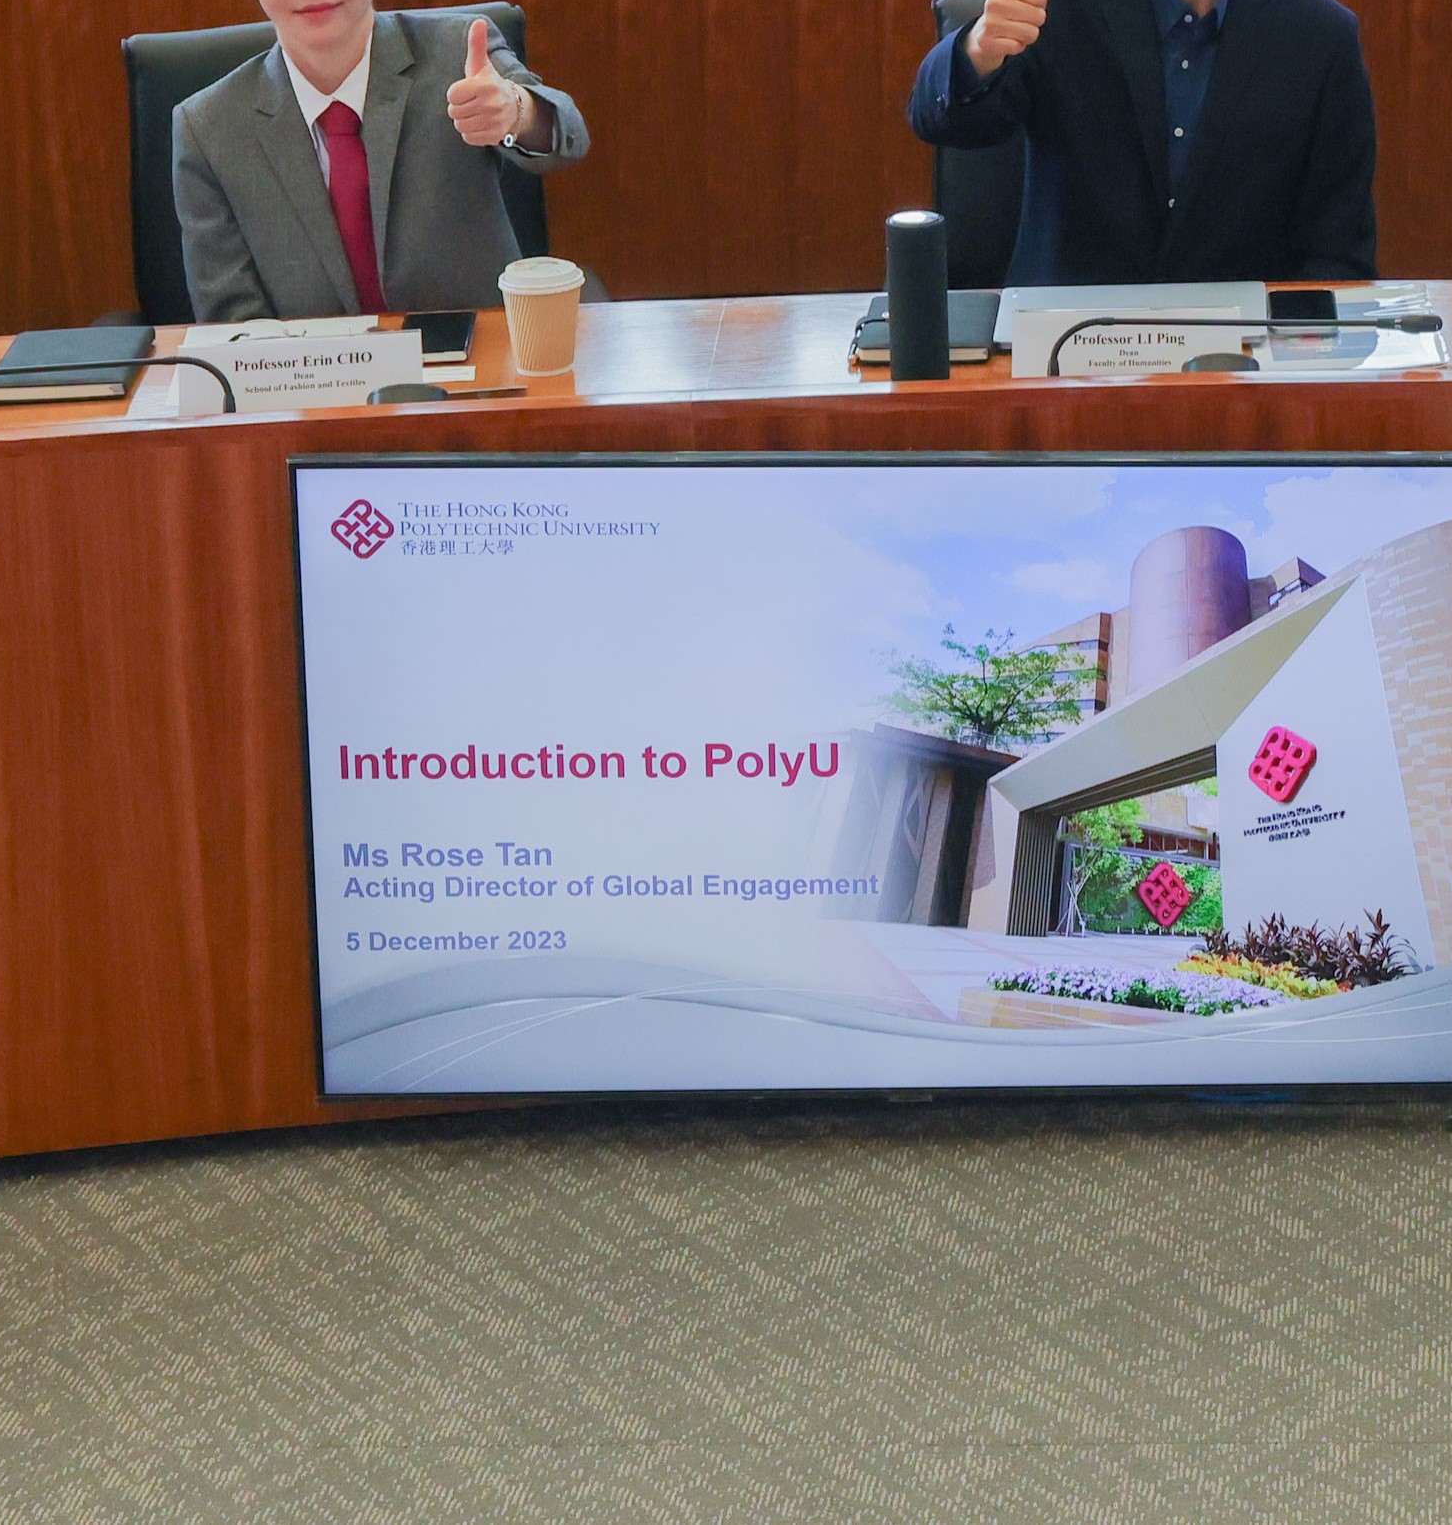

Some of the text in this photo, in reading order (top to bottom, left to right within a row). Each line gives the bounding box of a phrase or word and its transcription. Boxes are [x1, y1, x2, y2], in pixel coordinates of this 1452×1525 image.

[1073, 333, 1185, 346] Professor LI Ping
[234, 351, 372, 371] Professor Erin CHO
[245, 385, 272, 393] School
[284, 383, 315, 391] Fashion
[336, 379, 366, 387] Textiles
[398, 502, 569, 519] THE HONG KONG
[399, 520, 661, 538] POLYTECHNIC UNIVERSITY
[400, 538, 515, 556] 香港理工大學
[339, 742, 840, 786] Introduction to PolyU
[342, 842, 553, 868] Ms Rose Tan
[343, 873, 879, 903] Acting Director of Global Engagement
[346, 929, 568, 952] 5 December 2023
